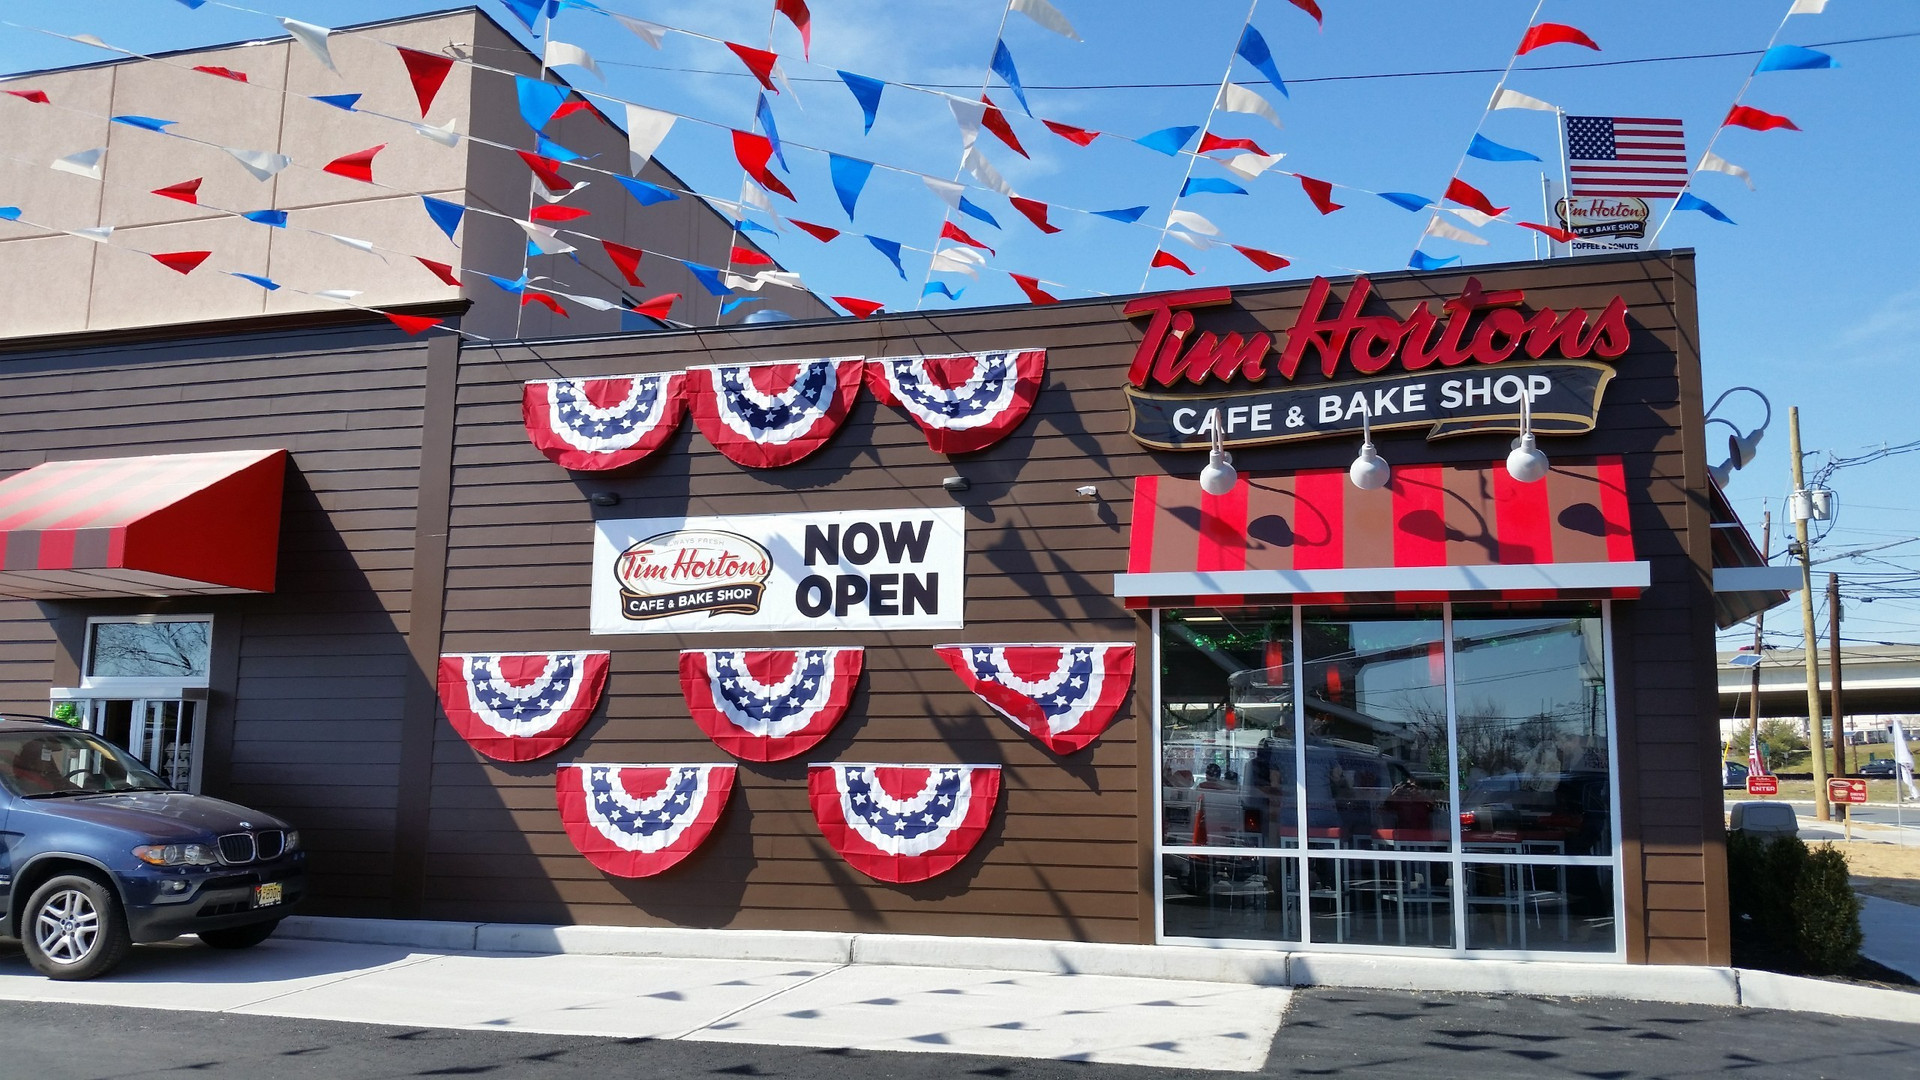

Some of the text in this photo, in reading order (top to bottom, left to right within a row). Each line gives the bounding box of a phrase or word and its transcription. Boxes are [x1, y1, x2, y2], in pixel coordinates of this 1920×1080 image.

[1589, 199, 1646, 217] Hortons
[1596, 225, 1617, 233] BAKE
[1618, 223, 1639, 231] SHOP
[1572, 242, 1600, 250] COFFEE
[1122, 275, 1632, 388] Tim Hortons
[1173, 374, 1552, 436] CAFE & BAKE SHOP
[804, 520, 934, 567] NOW
[622, 549, 668, 581] Tim
[671, 547, 768, 579] Hortons
[629, 588, 753, 612] CAFE & BAKE SHOP
[795, 572, 939, 619] OPEN
